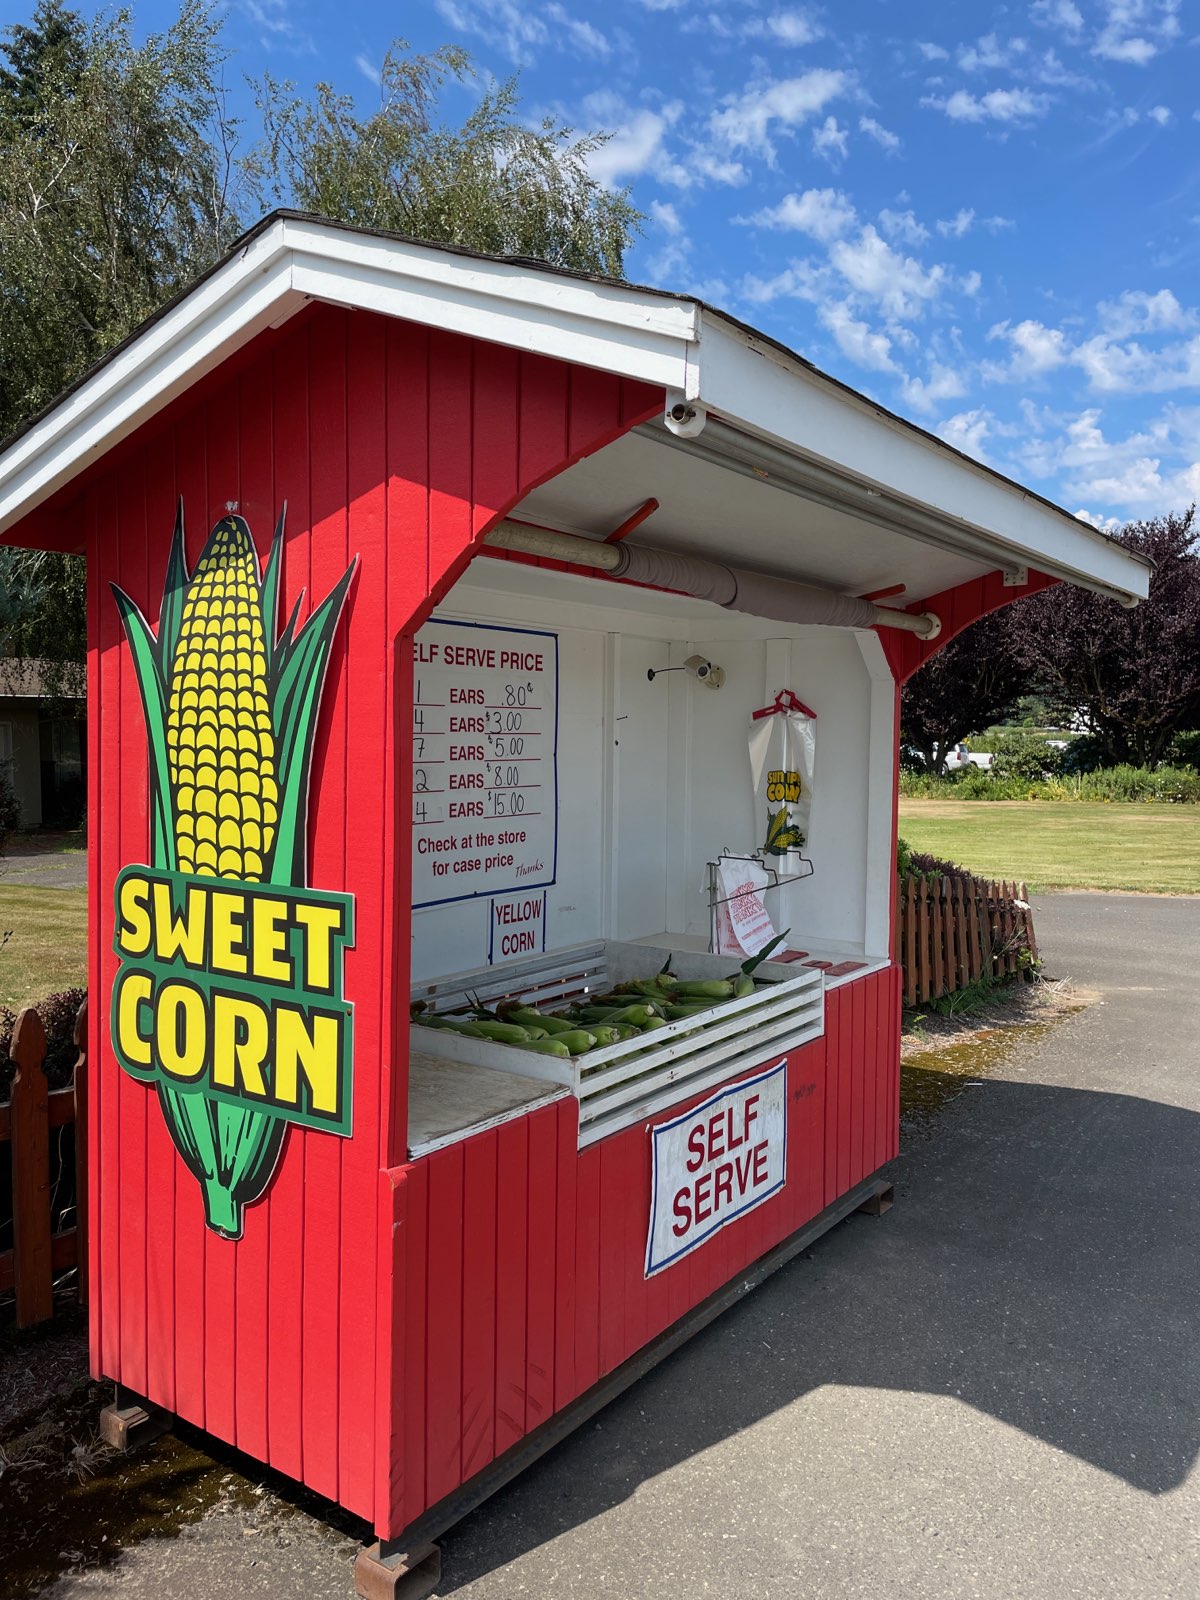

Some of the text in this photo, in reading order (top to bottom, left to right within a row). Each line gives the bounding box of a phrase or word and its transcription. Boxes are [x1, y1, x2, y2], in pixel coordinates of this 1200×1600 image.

[444, 645, 496, 668] SERVE
[500, 651, 544, 671] PRICE
[450, 688, 485, 705] EARS
[415, 709, 522, 734] 4 EARS $3.00
[413, 735, 524, 761] 7 EARS $5.00
[416, 763, 519, 791] 2 EARS $8.00
[412, 791, 525, 823] 4 EARS $15.00
[417, 831, 526, 854] Check at the store
[432, 853, 514, 876] for case price
[515, 859, 545, 878] Thanks
[496, 899, 541, 925] YELLOW
[119, 876, 343, 992] SWEET
[502, 930, 534, 955] CORN
[118, 971, 341, 1118] CORN
[686, 1094, 760, 1173] SELF
[672, 1139, 769, 1237] SERVE
